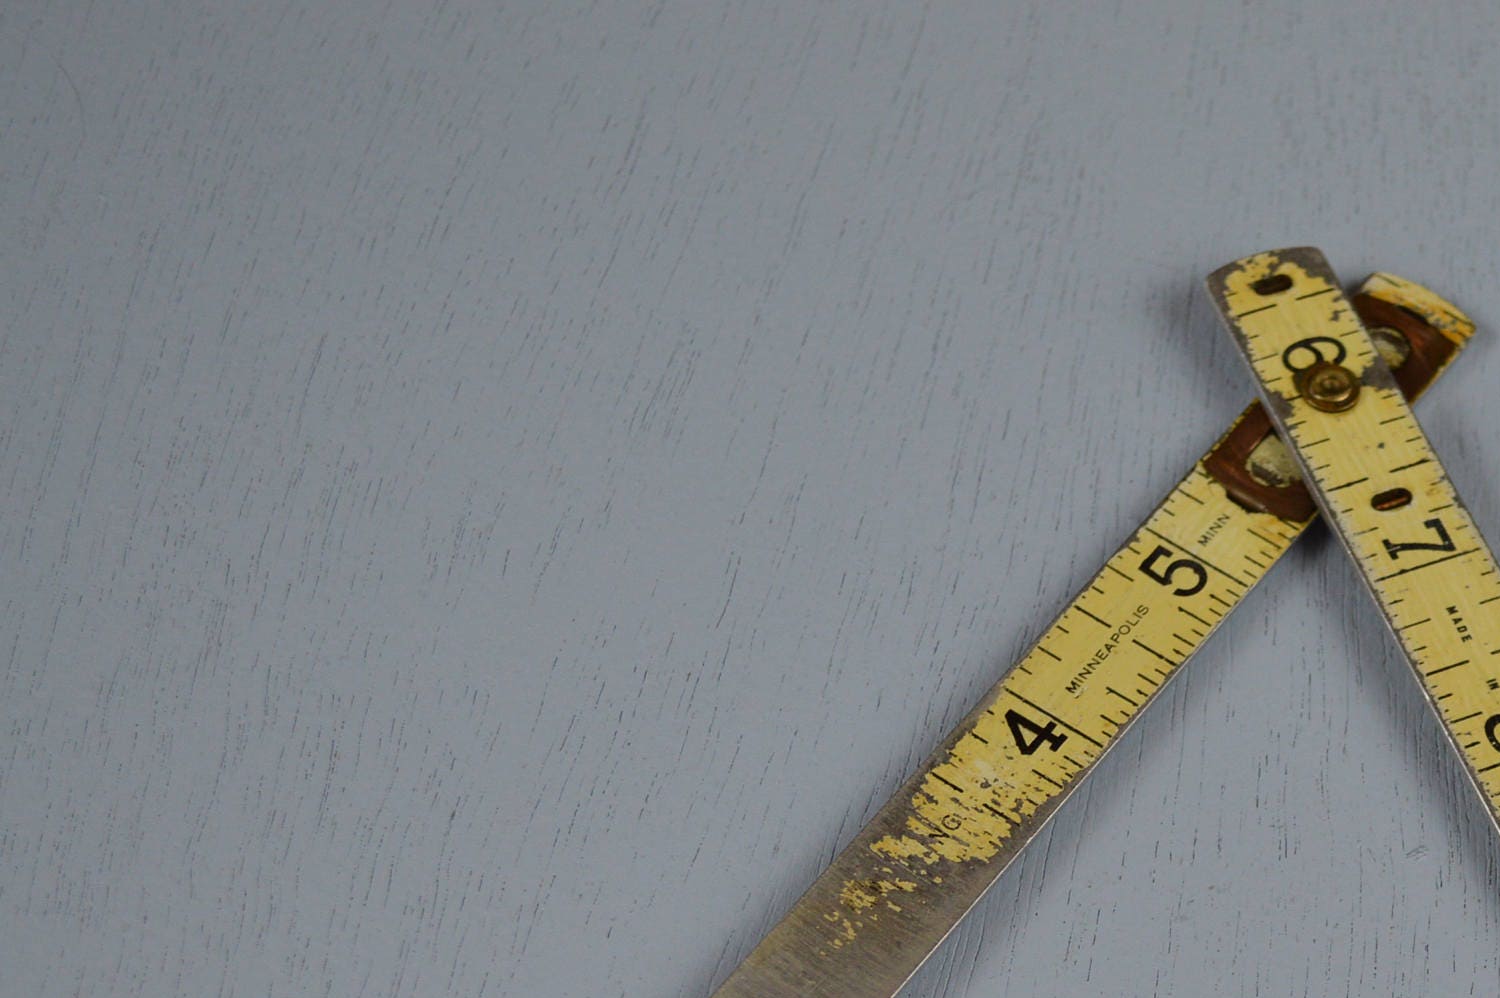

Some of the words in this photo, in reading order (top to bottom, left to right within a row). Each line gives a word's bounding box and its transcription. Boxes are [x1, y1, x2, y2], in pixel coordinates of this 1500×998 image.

[1282, 336, 1347, 375] 6
[1382, 518, 1457, 560] 7
[1138, 545, 1209, 596] 5
[1445, 604, 1474, 643] MADE
[1065, 603, 1150, 695] MINNEAPOLIS
[1004, 708, 1069, 757] 4
